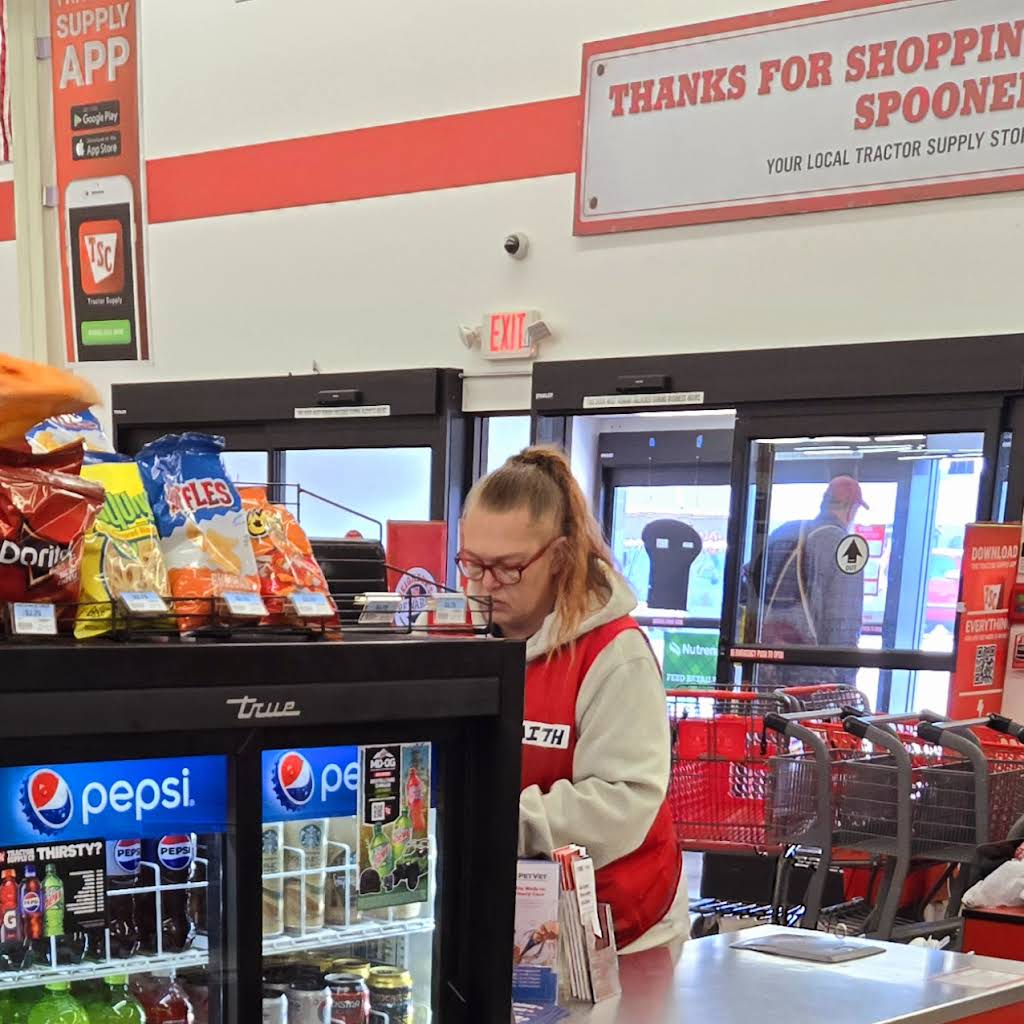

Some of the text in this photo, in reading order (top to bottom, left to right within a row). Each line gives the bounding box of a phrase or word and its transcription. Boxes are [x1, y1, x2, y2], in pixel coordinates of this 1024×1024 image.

[56, 4, 129, 38] SUPPLY
[59, 36, 130, 89] APP
[608, 64, 747, 117] THANKS
[757, 51, 833, 96] FOR
[83, 111, 118, 125] Google Play
[86, 142, 117, 156] App Store
[767, 158, 803, 175] YOUR
[807, 150, 850, 170] LOCAL
[855, 140, 922, 164] TRACTOR
[927, 131, 986, 154] SUPPLY
[88, 237, 112, 272] TSC
[489, 312, 527, 352] EXIT
[971, 545, 1019, 560] DOWNLOAD
[226, 695, 302, 720] true
[81, 767, 192, 825] pepsi
[36, 841, 103, 861] THIRSTY?
[117, 848, 141, 858] PEPS
[161, 846, 191, 856] PEPSI
[3, 909, 17, 929] G
